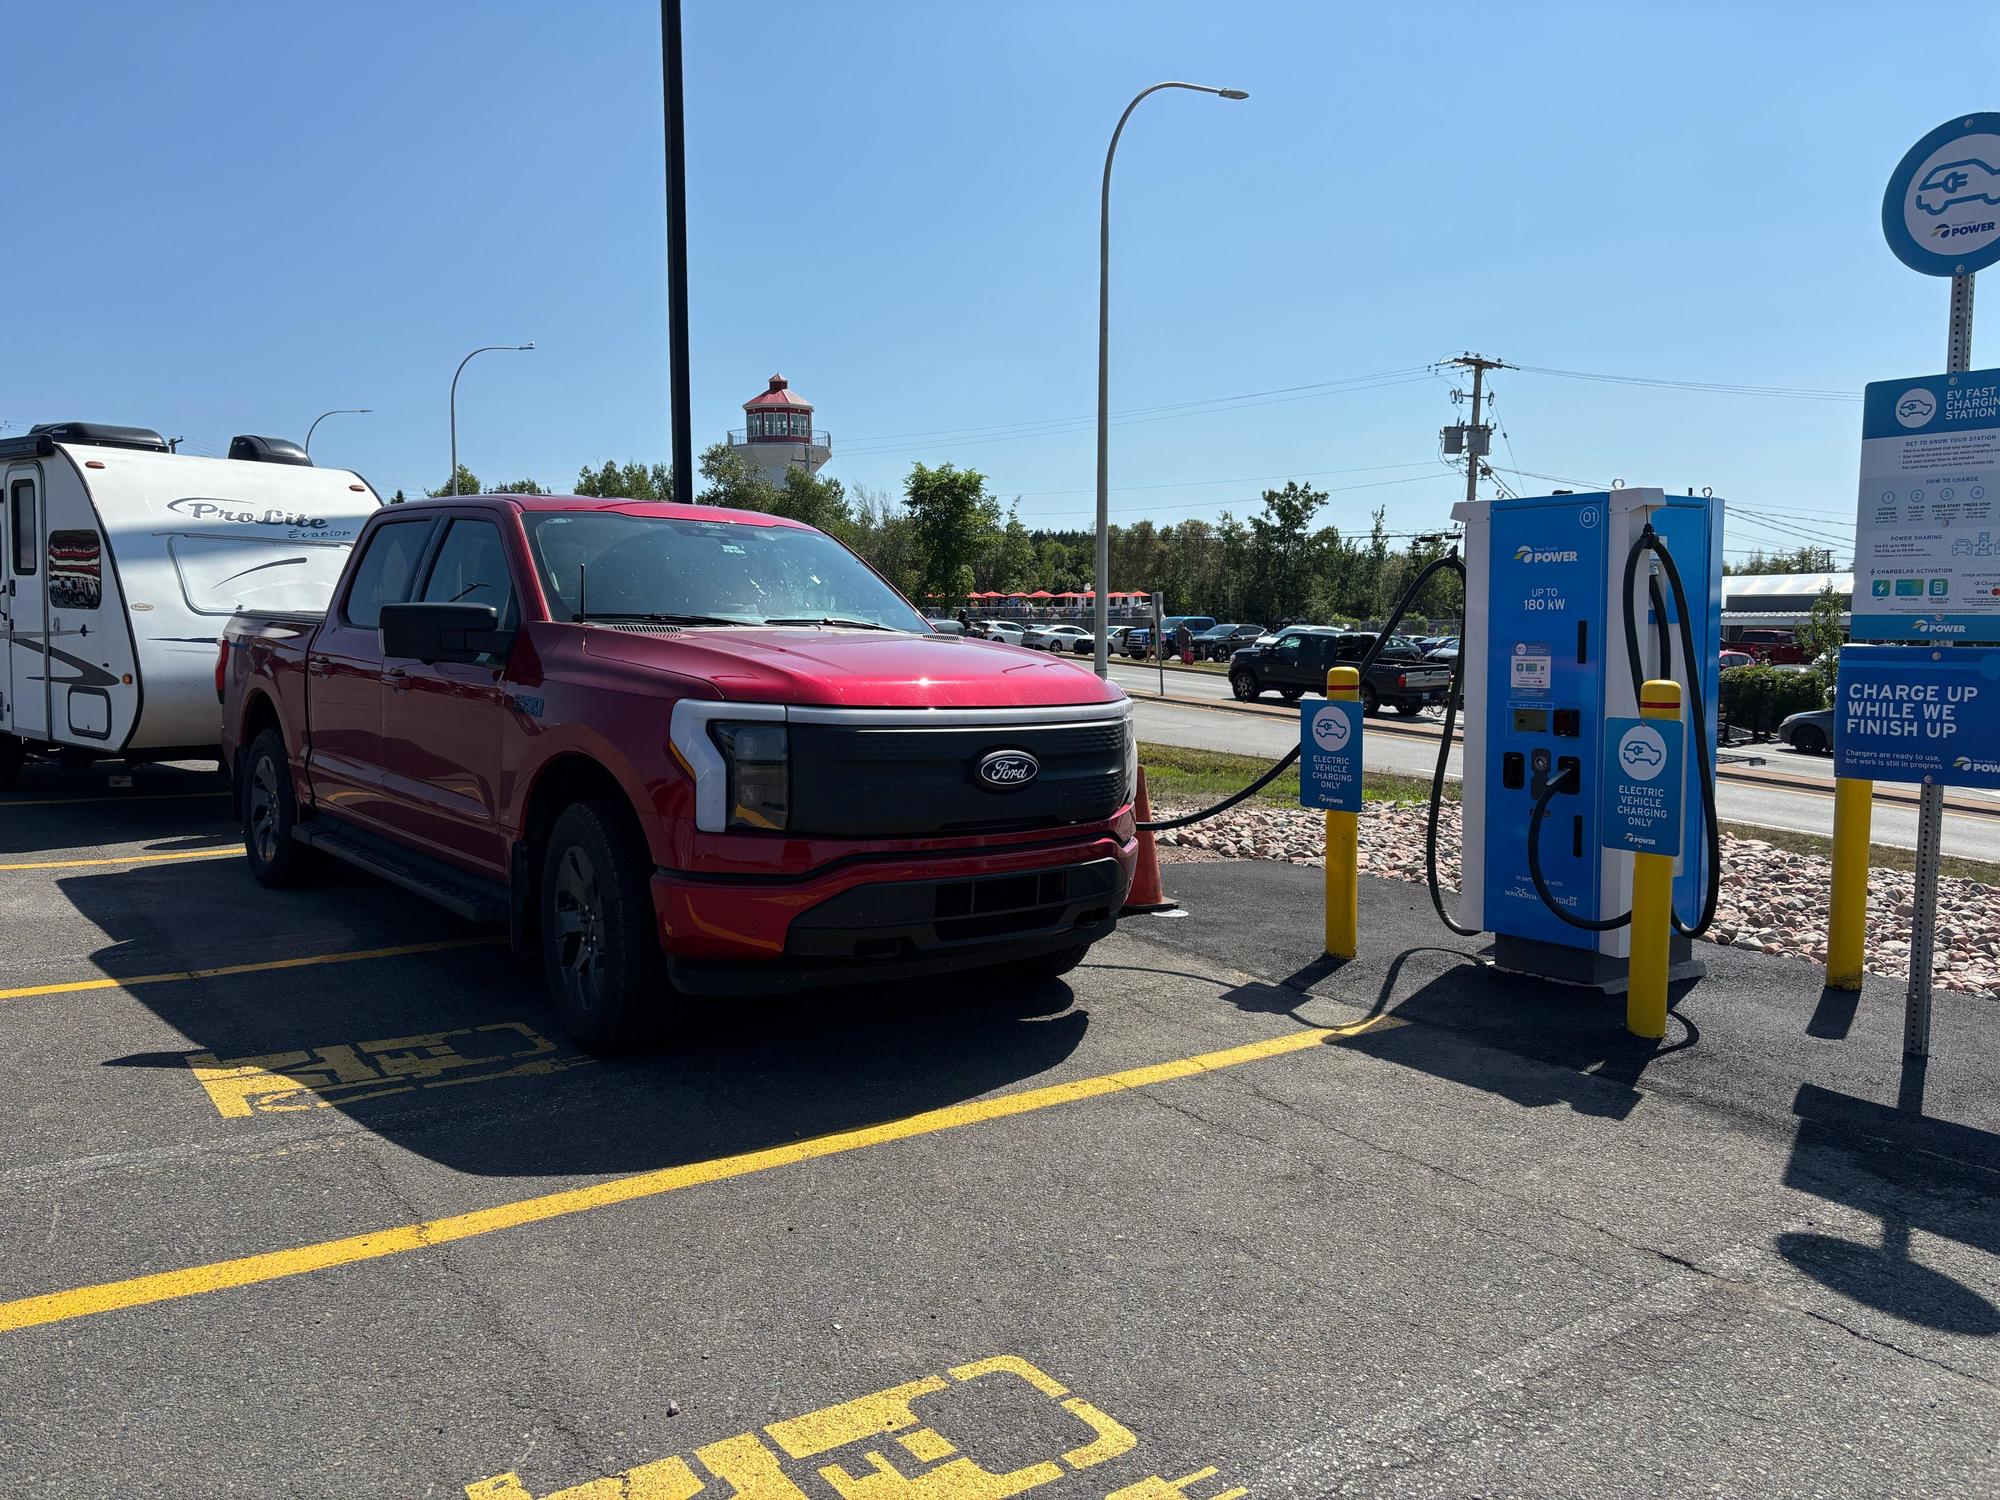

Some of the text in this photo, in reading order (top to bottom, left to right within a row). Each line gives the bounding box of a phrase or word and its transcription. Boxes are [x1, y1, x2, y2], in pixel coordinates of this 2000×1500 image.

[1951, 221, 1995, 237] POWER
[1946, 386, 1997, 400] EV FAST
[1945, 396, 2000, 410] CHARGIN
[1945, 407, 1996, 420] STATION
[1969, 434, 1996, 442] STATION
[1583, 512, 1596, 523] 01
[1534, 551, 1578, 563] POWER
[1531, 588, 1558, 597] UP TO
[1523, 598, 1566, 610] 180 kW
[1929, 624, 1966, 633] POWER
[1849, 683, 1978, 703] CHARGE UP
[1848, 701, 1956, 720] WHILE WE
[1846, 718, 1957, 738] FINISH UP
[1312, 755, 1350, 765] ELECTRIC
[1845, 750, 1877, 759] Chargers
[1892, 752, 1914, 761] ready
[991, 760, 1029, 780] Ford
[1314, 763, 1348, 773] VEHICLE
[1885, 759, 1900, 767] still
[1909, 761, 1943, 770] progress
[1973, 763, 2000, 773] POW
[1312, 771, 1352, 782] CHARGING
[1320, 780, 1341, 789] ONLY
[1618, 785, 1665, 798] ELECTRIC
[1620, 795, 1662, 808] VEHICLE
[1617, 806, 1668, 819] CHARGING
[1627, 817, 1653, 828] ONLY
[1634, 837, 1656, 846] POWER
